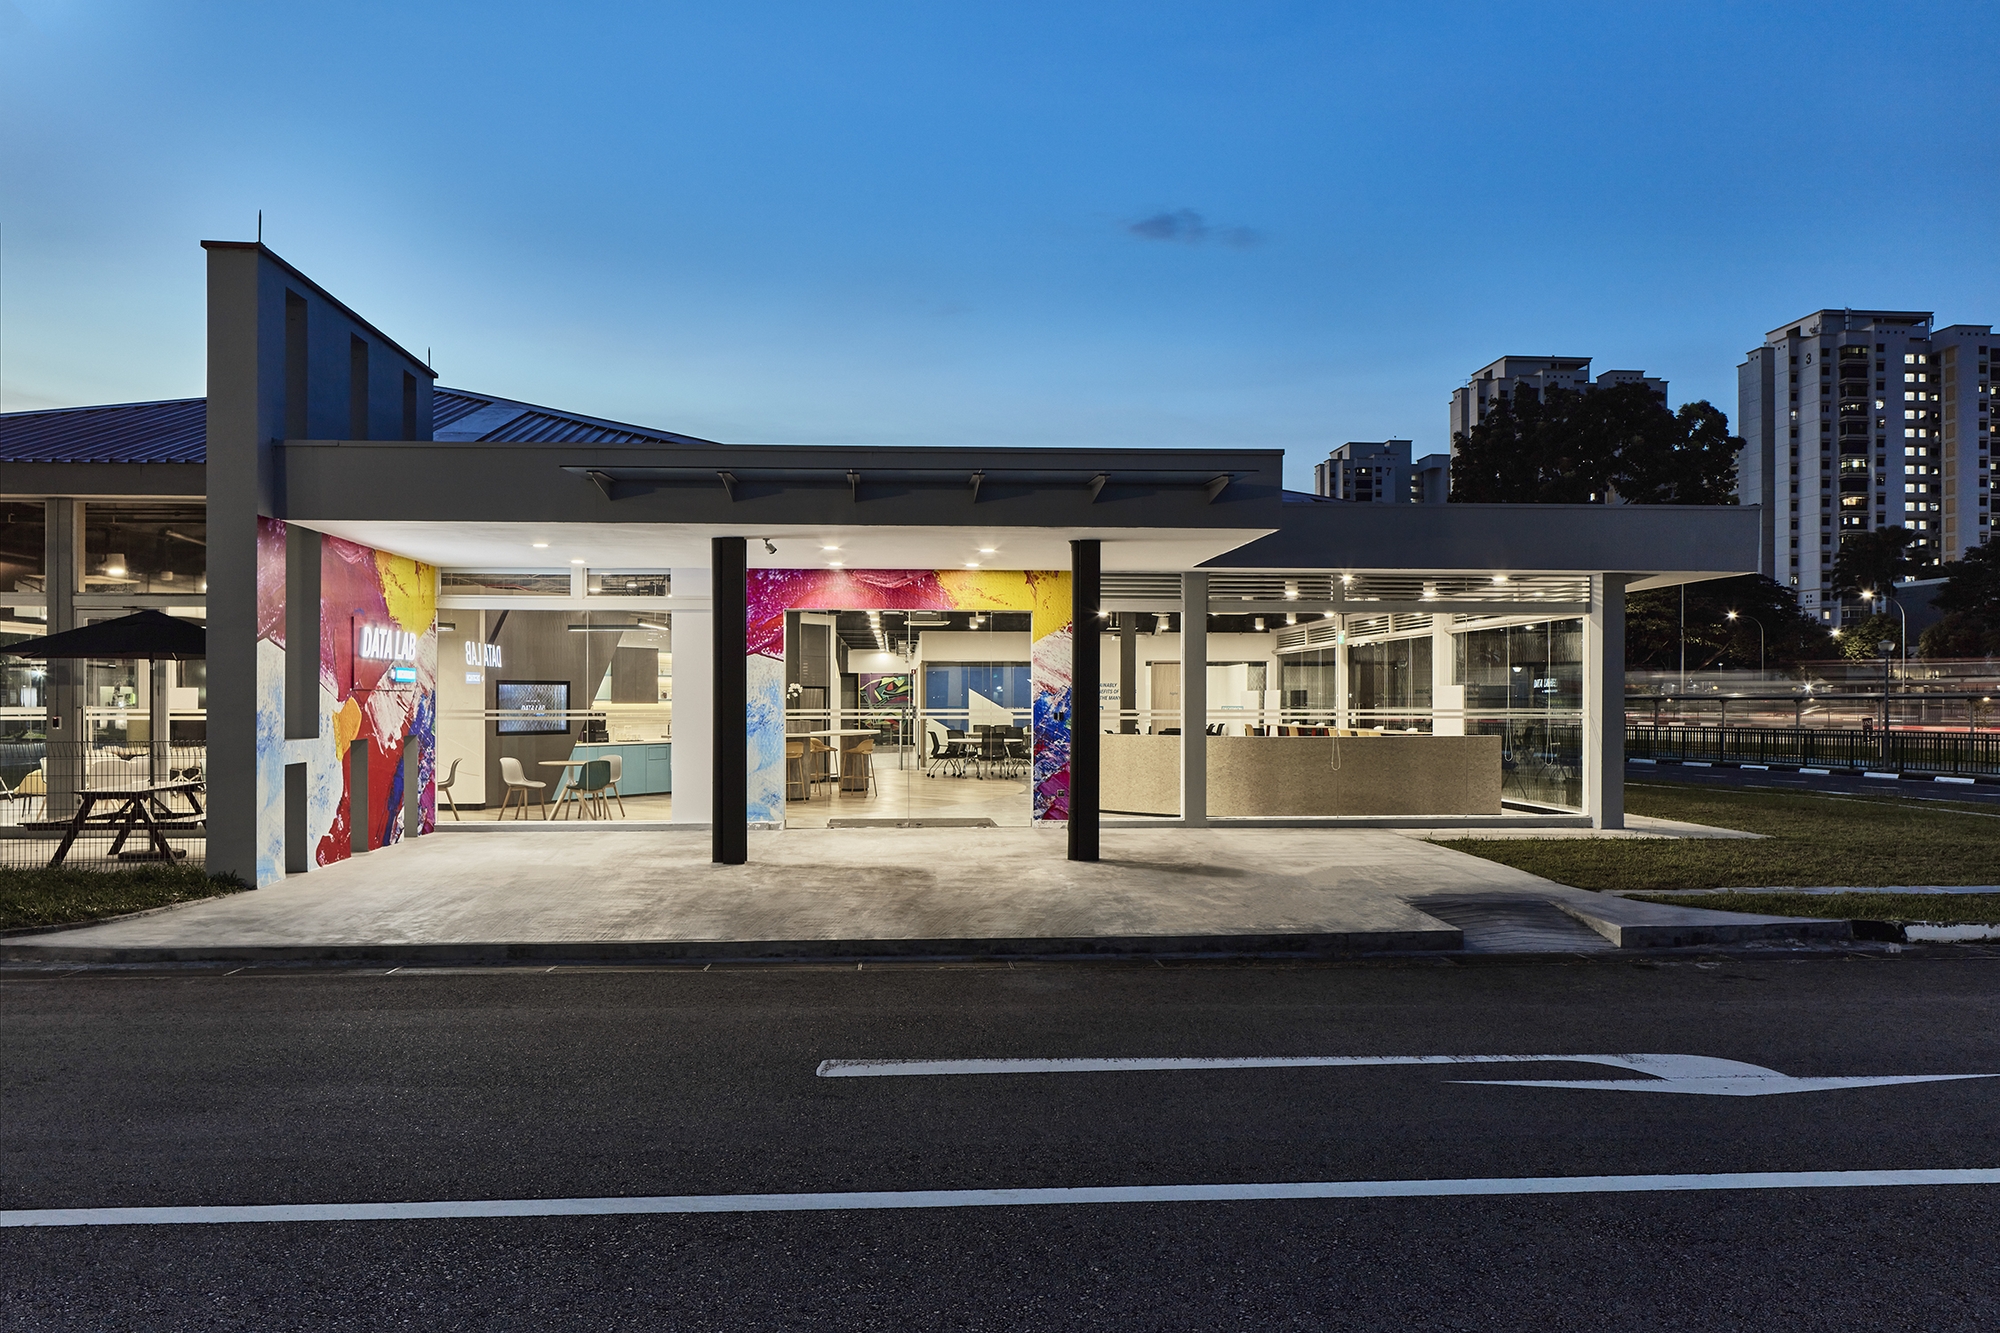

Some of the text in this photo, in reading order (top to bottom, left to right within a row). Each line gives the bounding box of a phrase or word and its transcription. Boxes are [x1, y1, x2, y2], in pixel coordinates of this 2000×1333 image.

[1805, 352, 1812, 365] 3
[1385, 467, 1392, 476] 7
[361, 626, 416, 661] DATA LAB
